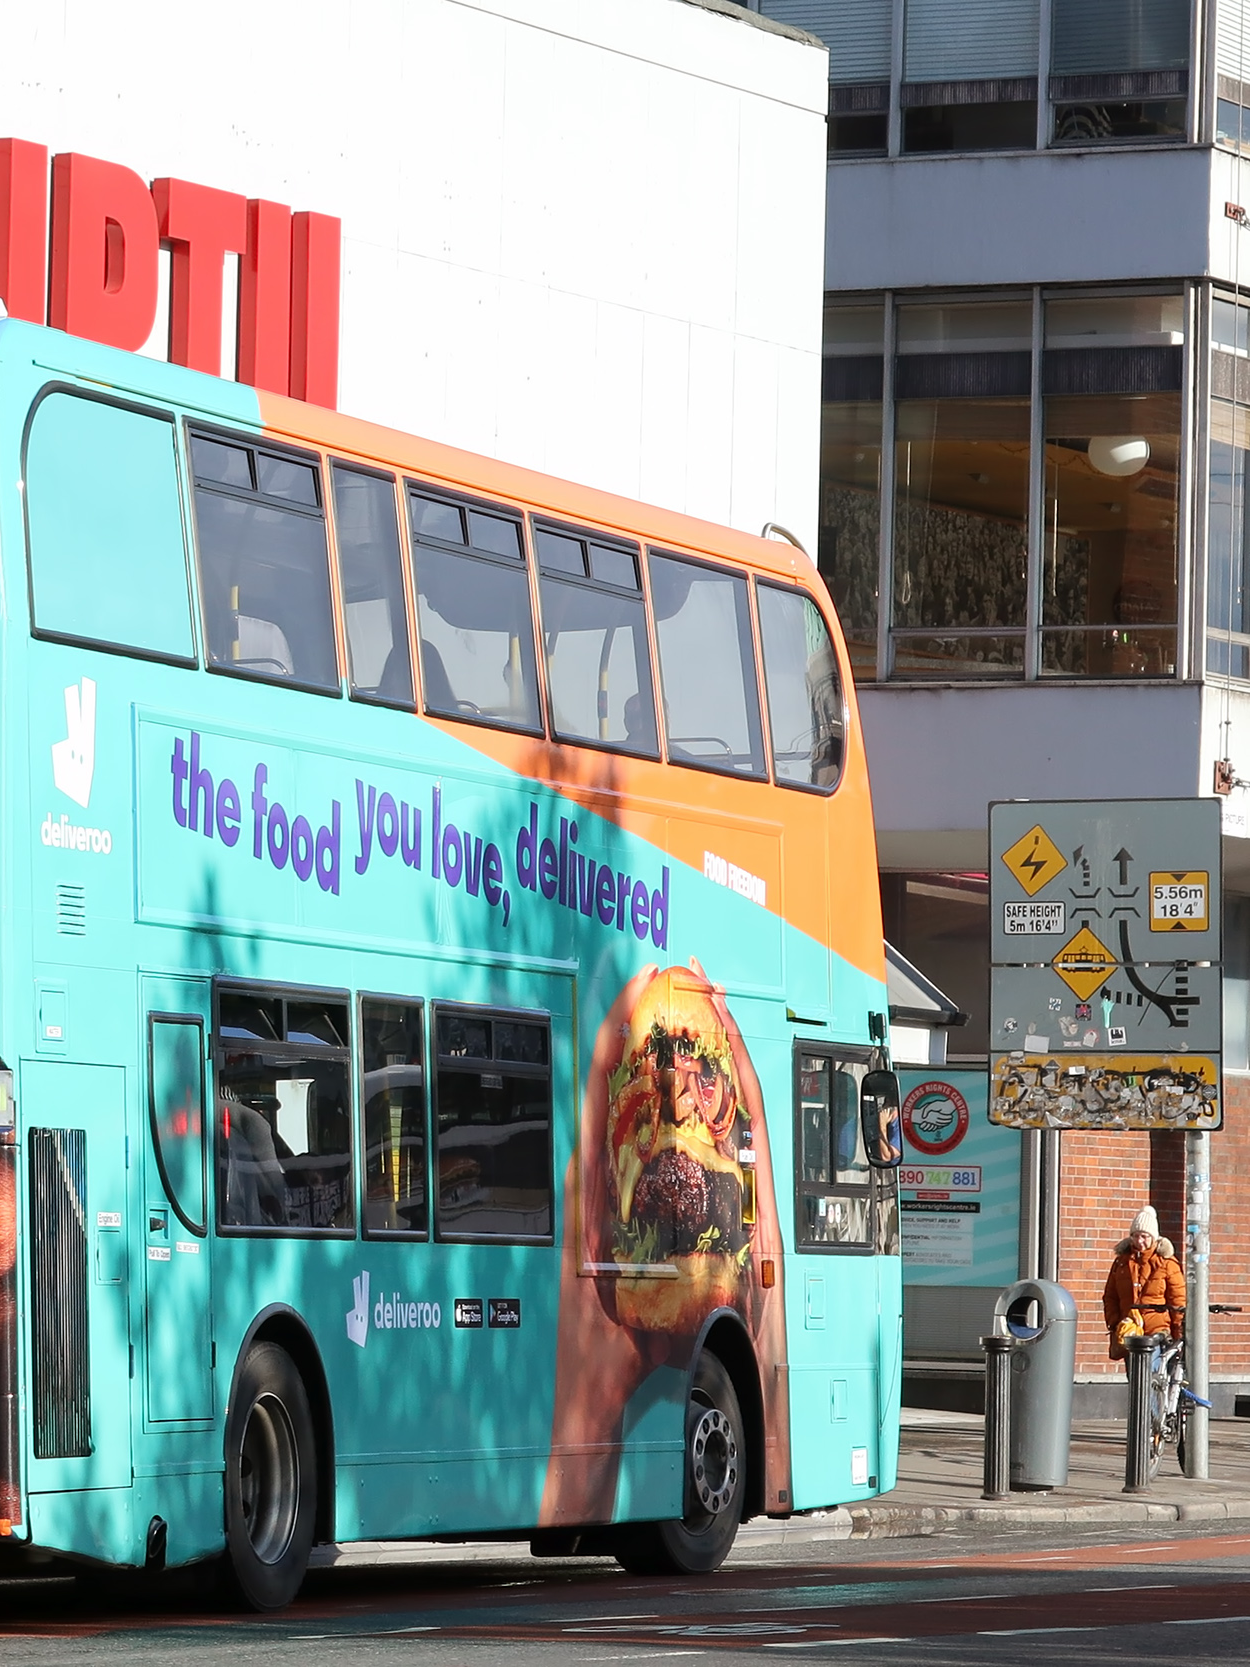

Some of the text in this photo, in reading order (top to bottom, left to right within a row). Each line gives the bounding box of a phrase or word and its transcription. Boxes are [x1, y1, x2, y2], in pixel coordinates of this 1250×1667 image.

[41, 811, 112, 855] deliveroo
[171, 730, 670, 951] the food you love, delivered
[703, 850, 766, 907] FOOD FREEDOM
[1154, 886, 1203, 899] 5.56m
[1006, 905, 1062, 918] SAFE HEIGHT
[1009, 921, 1026, 932] 5m
[903, 1087, 925, 1119] WORKERS
[925, 1084, 951, 1095] RIGHTS
[950, 1091, 967, 1119] CENTRE
[926, 1171, 950, 1184] 747
[952, 1172, 977, 1186] 881
[374, 1292, 441, 1329] deliveroo
[462, 1311, 481, 1324] App Store
[497, 1310, 519, 1324] Google Play
